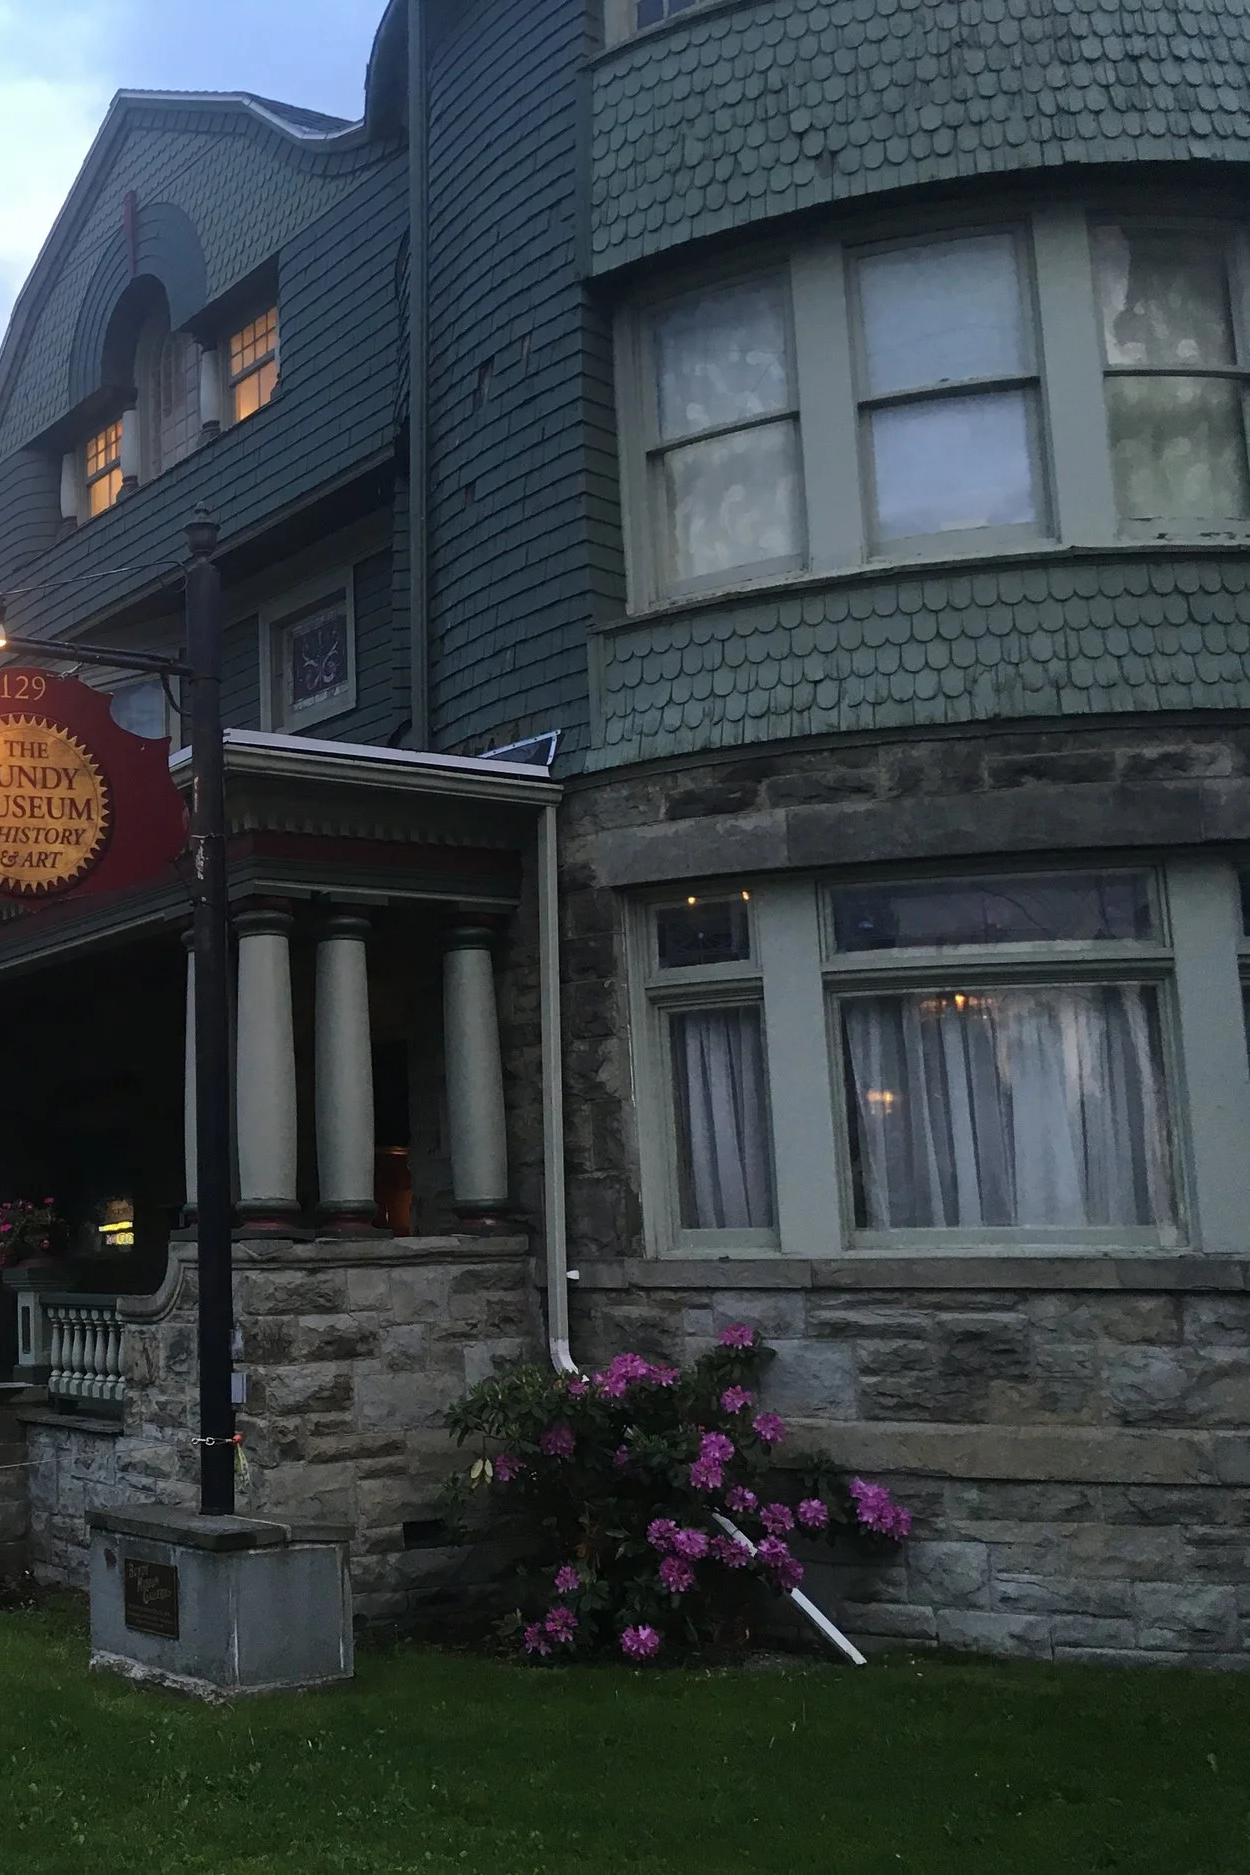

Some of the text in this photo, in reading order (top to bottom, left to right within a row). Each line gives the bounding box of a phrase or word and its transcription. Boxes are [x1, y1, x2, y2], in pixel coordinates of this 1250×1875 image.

[0, 674, 47, 701] 129
[4, 740, 49, 759] THE
[0, 850, 63, 869] & ART
